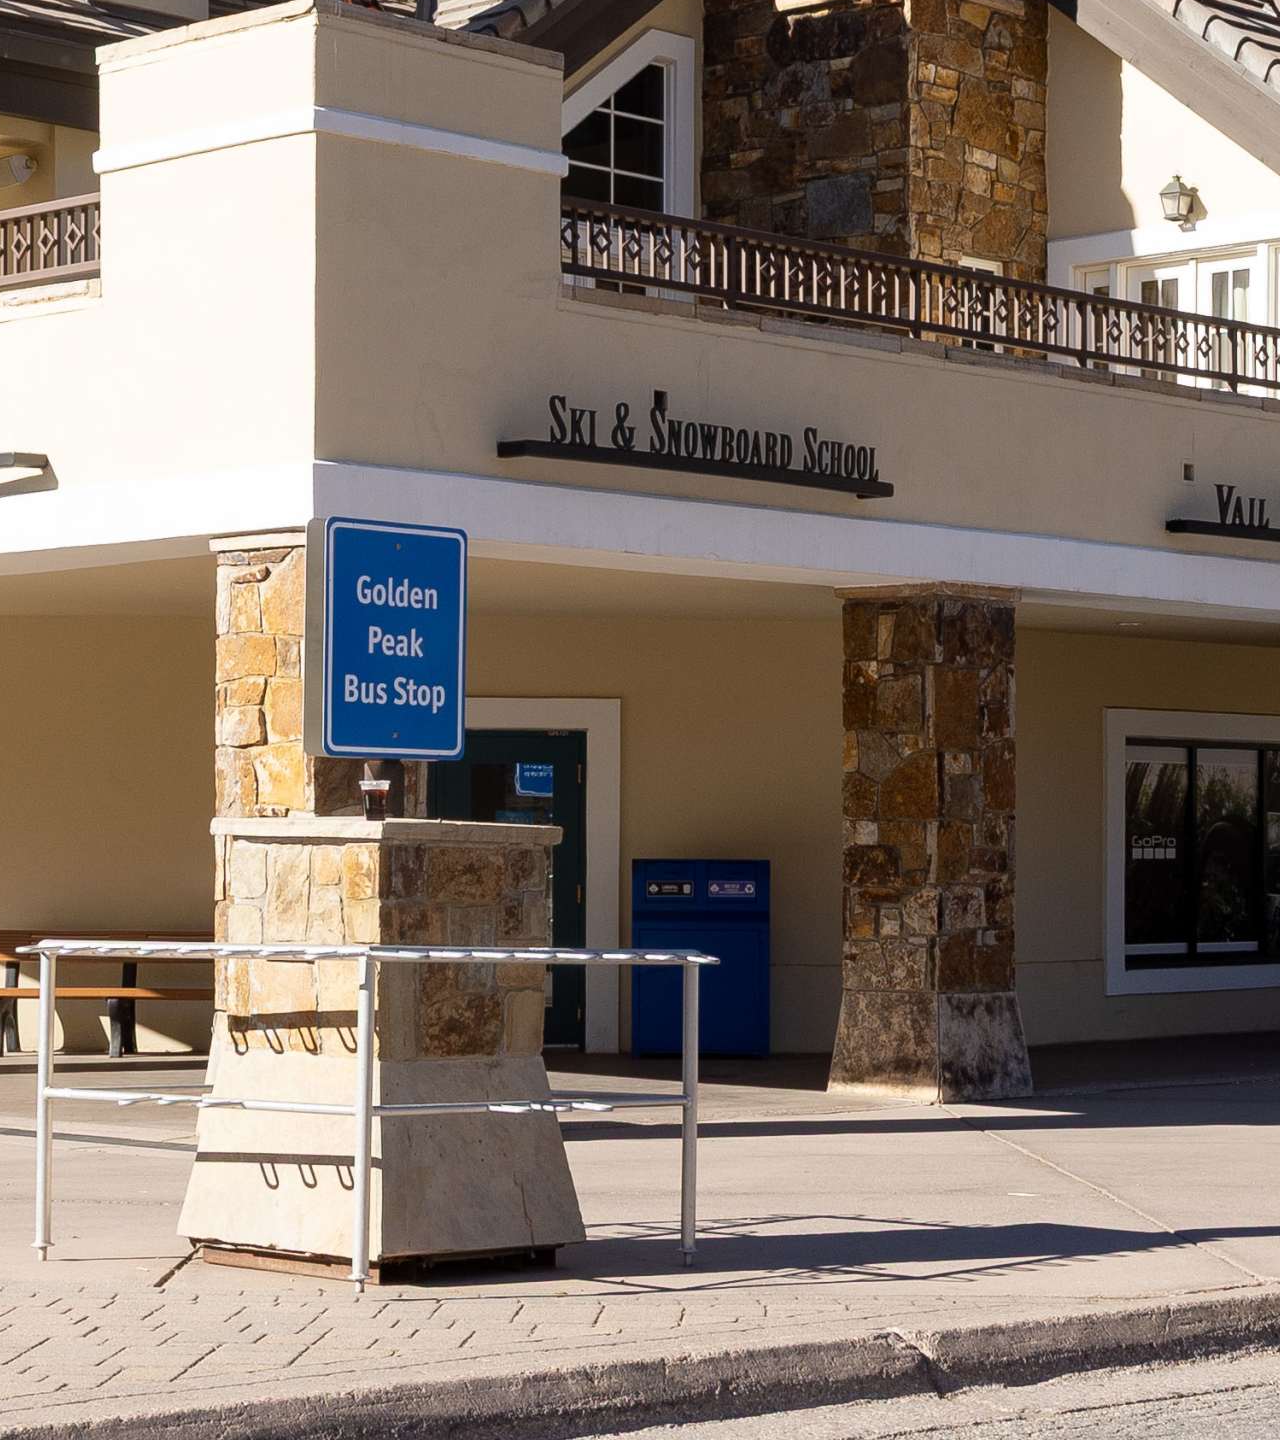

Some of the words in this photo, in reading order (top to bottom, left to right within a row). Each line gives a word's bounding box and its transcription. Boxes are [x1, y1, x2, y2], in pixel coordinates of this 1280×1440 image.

[548, 395, 599, 448] SKI
[611, 402, 636, 451] &
[650, 405, 793, 471] SNOWBOARD
[803, 427, 880, 481] SCHOOL
[1214, 484, 1270, 528] VAIL
[356, 574, 438, 610] Golden
[368, 625, 424, 658] Peak
[344, 674, 387, 705] Bus
[393, 676, 446, 714] Stop
[1131, 835, 1176, 847] GoPro
